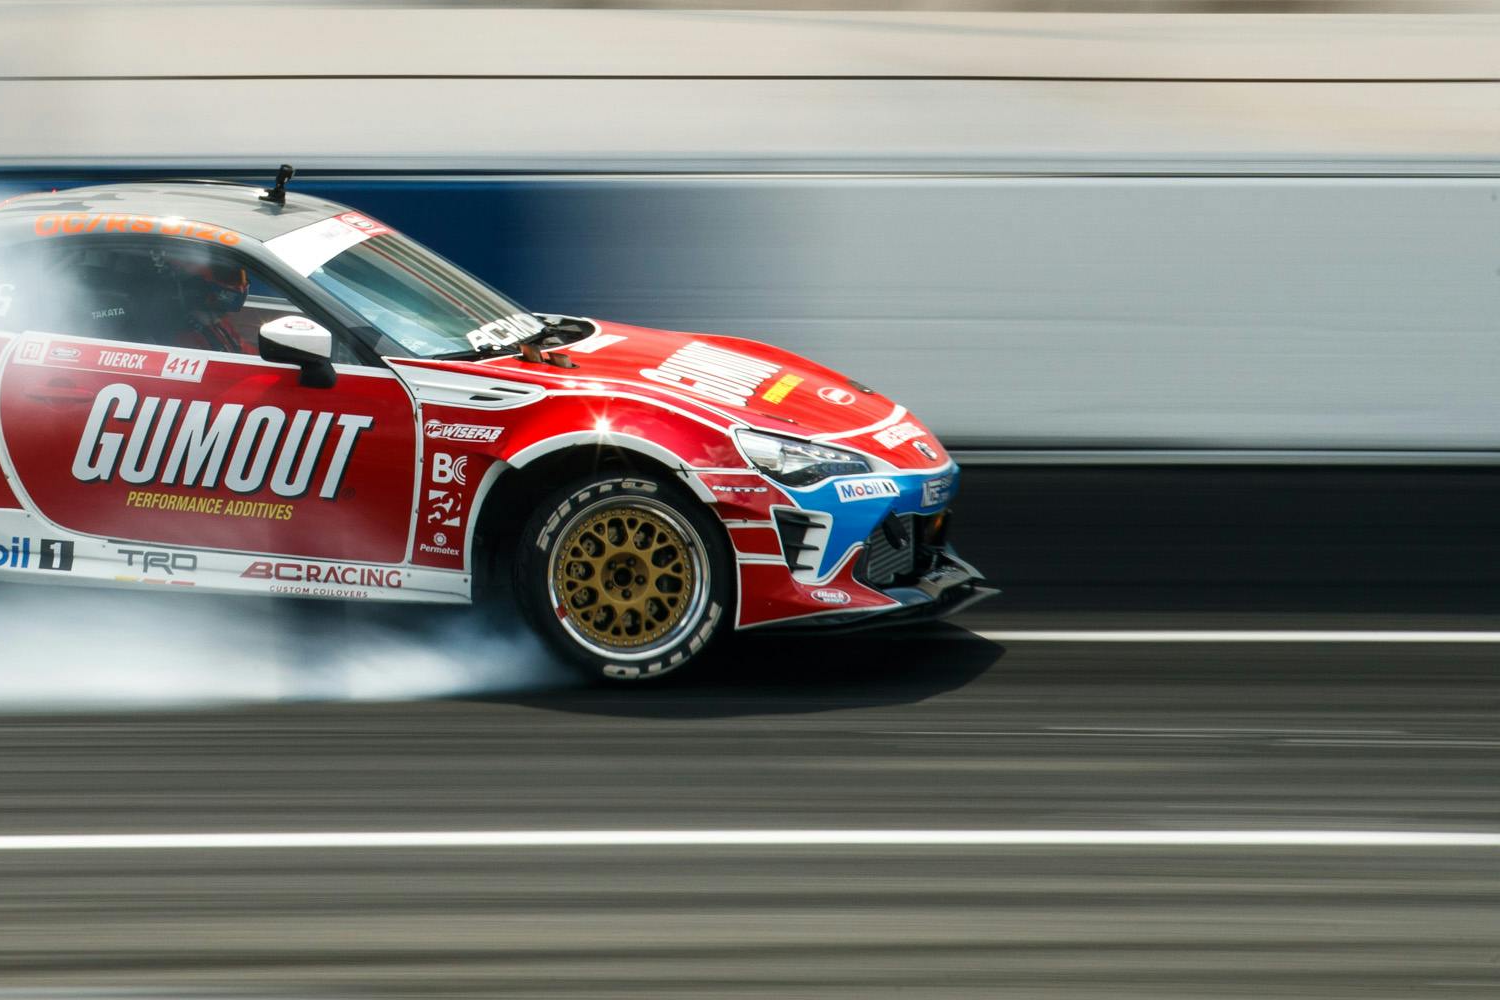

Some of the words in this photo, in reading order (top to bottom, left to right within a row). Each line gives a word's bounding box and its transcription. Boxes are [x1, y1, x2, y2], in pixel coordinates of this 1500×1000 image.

[91, 307, 125, 320] TAKATA
[98, 350, 148, 370] TUERCK
[166, 357, 201, 376] 411
[72, 383, 374, 500] GUMOUT
[442, 424, 503, 441] WISEFAB
[840, 481, 883, 499] Mobil
[126, 491, 223, 517] PERFORMANCE
[224, 502, 293, 521] ADDITIVES
[419, 543, 460, 556] Permatex
[117, 549, 198, 575] TRD
[269, 584, 310, 594] CUSTOM
[312, 588, 369, 598] COILOVERS
